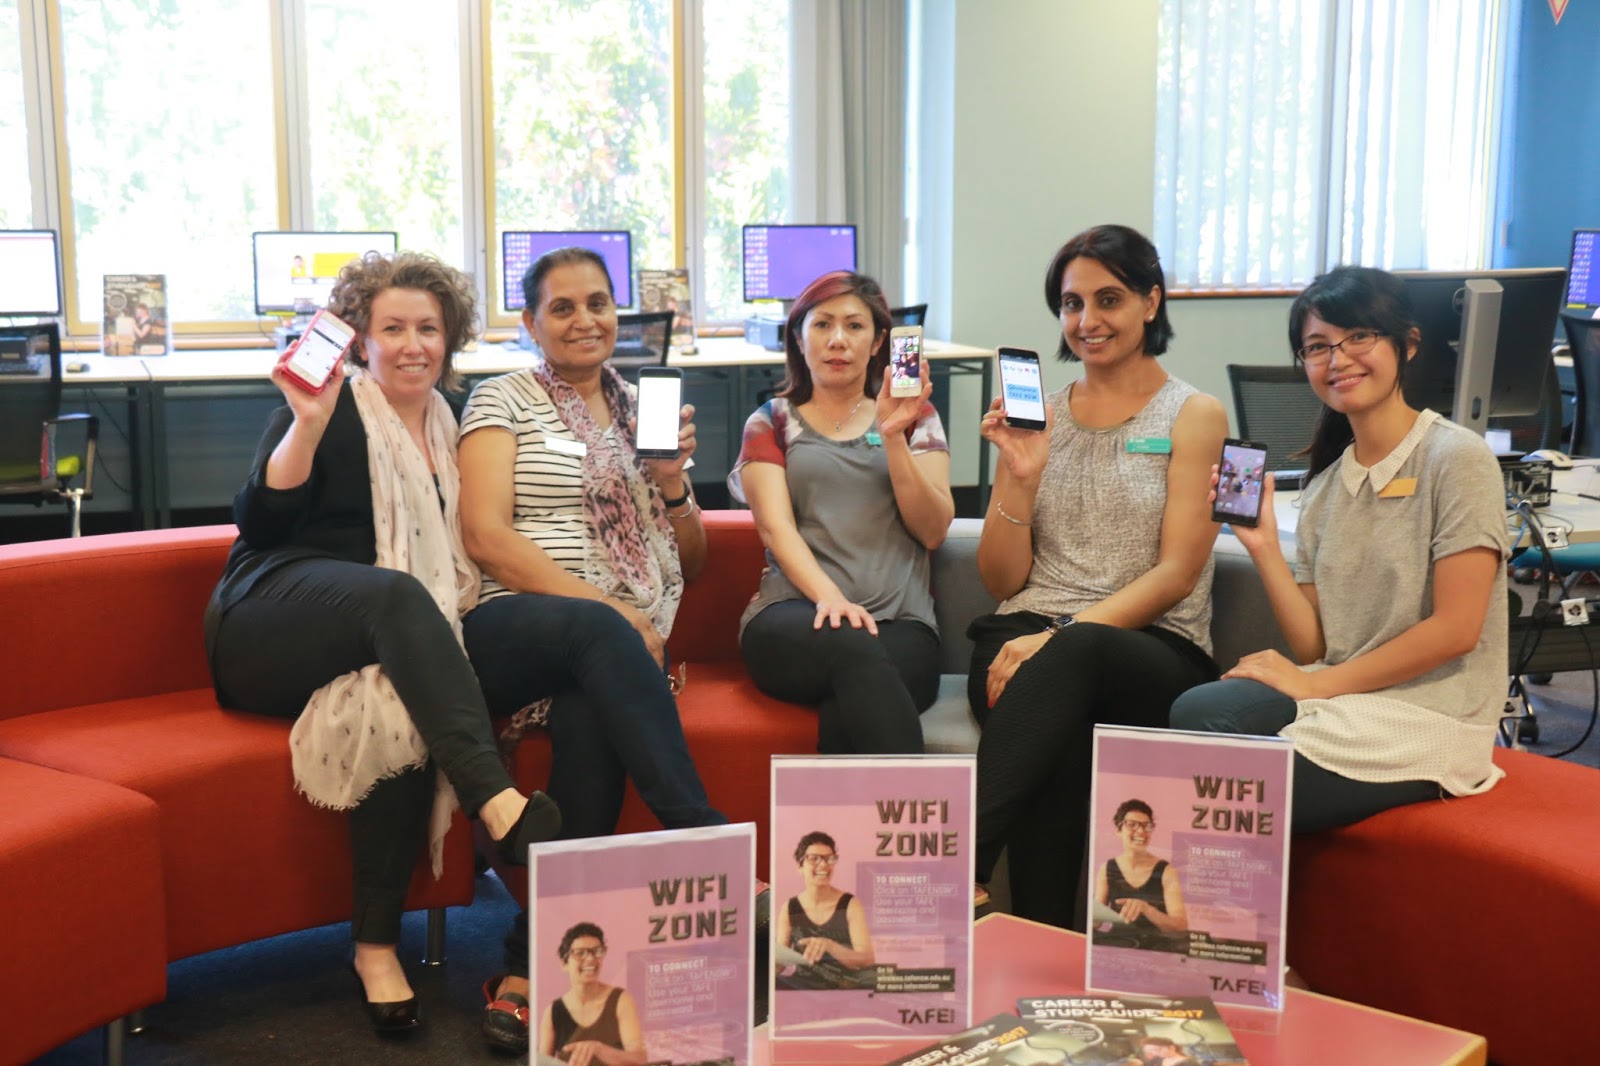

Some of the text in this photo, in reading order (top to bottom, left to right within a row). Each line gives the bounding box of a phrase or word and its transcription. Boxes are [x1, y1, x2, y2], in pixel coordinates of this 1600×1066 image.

[1193, 774, 1264, 803] WIFI
[876, 799, 948, 824] WIFI
[1192, 805, 1273, 835] ZONE
[876, 831, 958, 856] ZONE
[1203, 848, 1241, 858] CONNECT
[876, 875, 927, 884] TO CONNECT
[649, 873, 727, 906] WIFI
[648, 907, 737, 943] ZONE
[649, 959, 704, 973] TO CONNECT
[1210, 976, 1260, 995] TAFE
[1031, 999, 1124, 1008] CAREER &
[898, 1008, 949, 1024] TAFE
[1162, 1009, 1203, 1018] 2017
[942, 1044, 961, 1054] &
